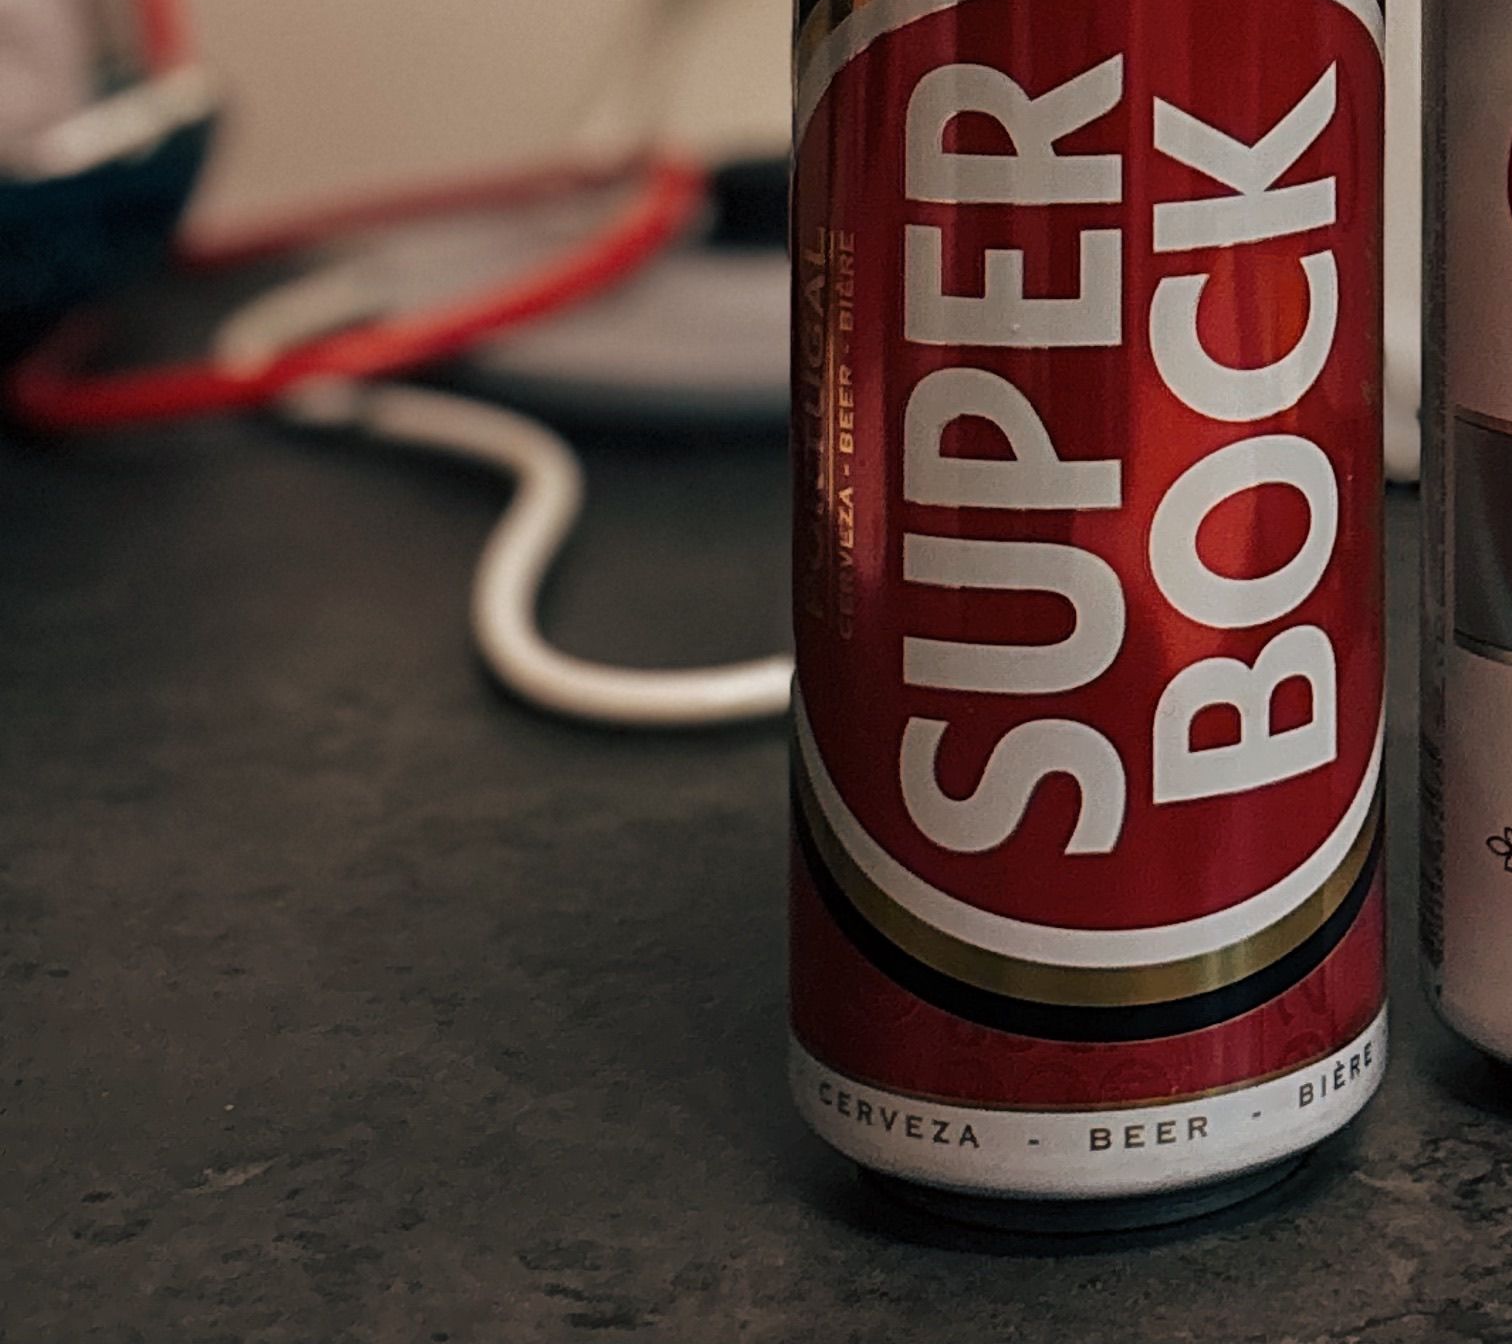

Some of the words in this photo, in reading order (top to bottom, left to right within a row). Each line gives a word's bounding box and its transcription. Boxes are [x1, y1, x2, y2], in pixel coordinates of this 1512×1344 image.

[838, 364, 854, 454] BEER
[899, 52, 1127, 855] SUPER
[1148, 60, 1340, 805] BOCK
[818, 1079, 980, 1149] CERVEZA
[1089, 1115, 1209, 1151] BEER
[1299, 1039, 1373, 1109] BIÈRE
